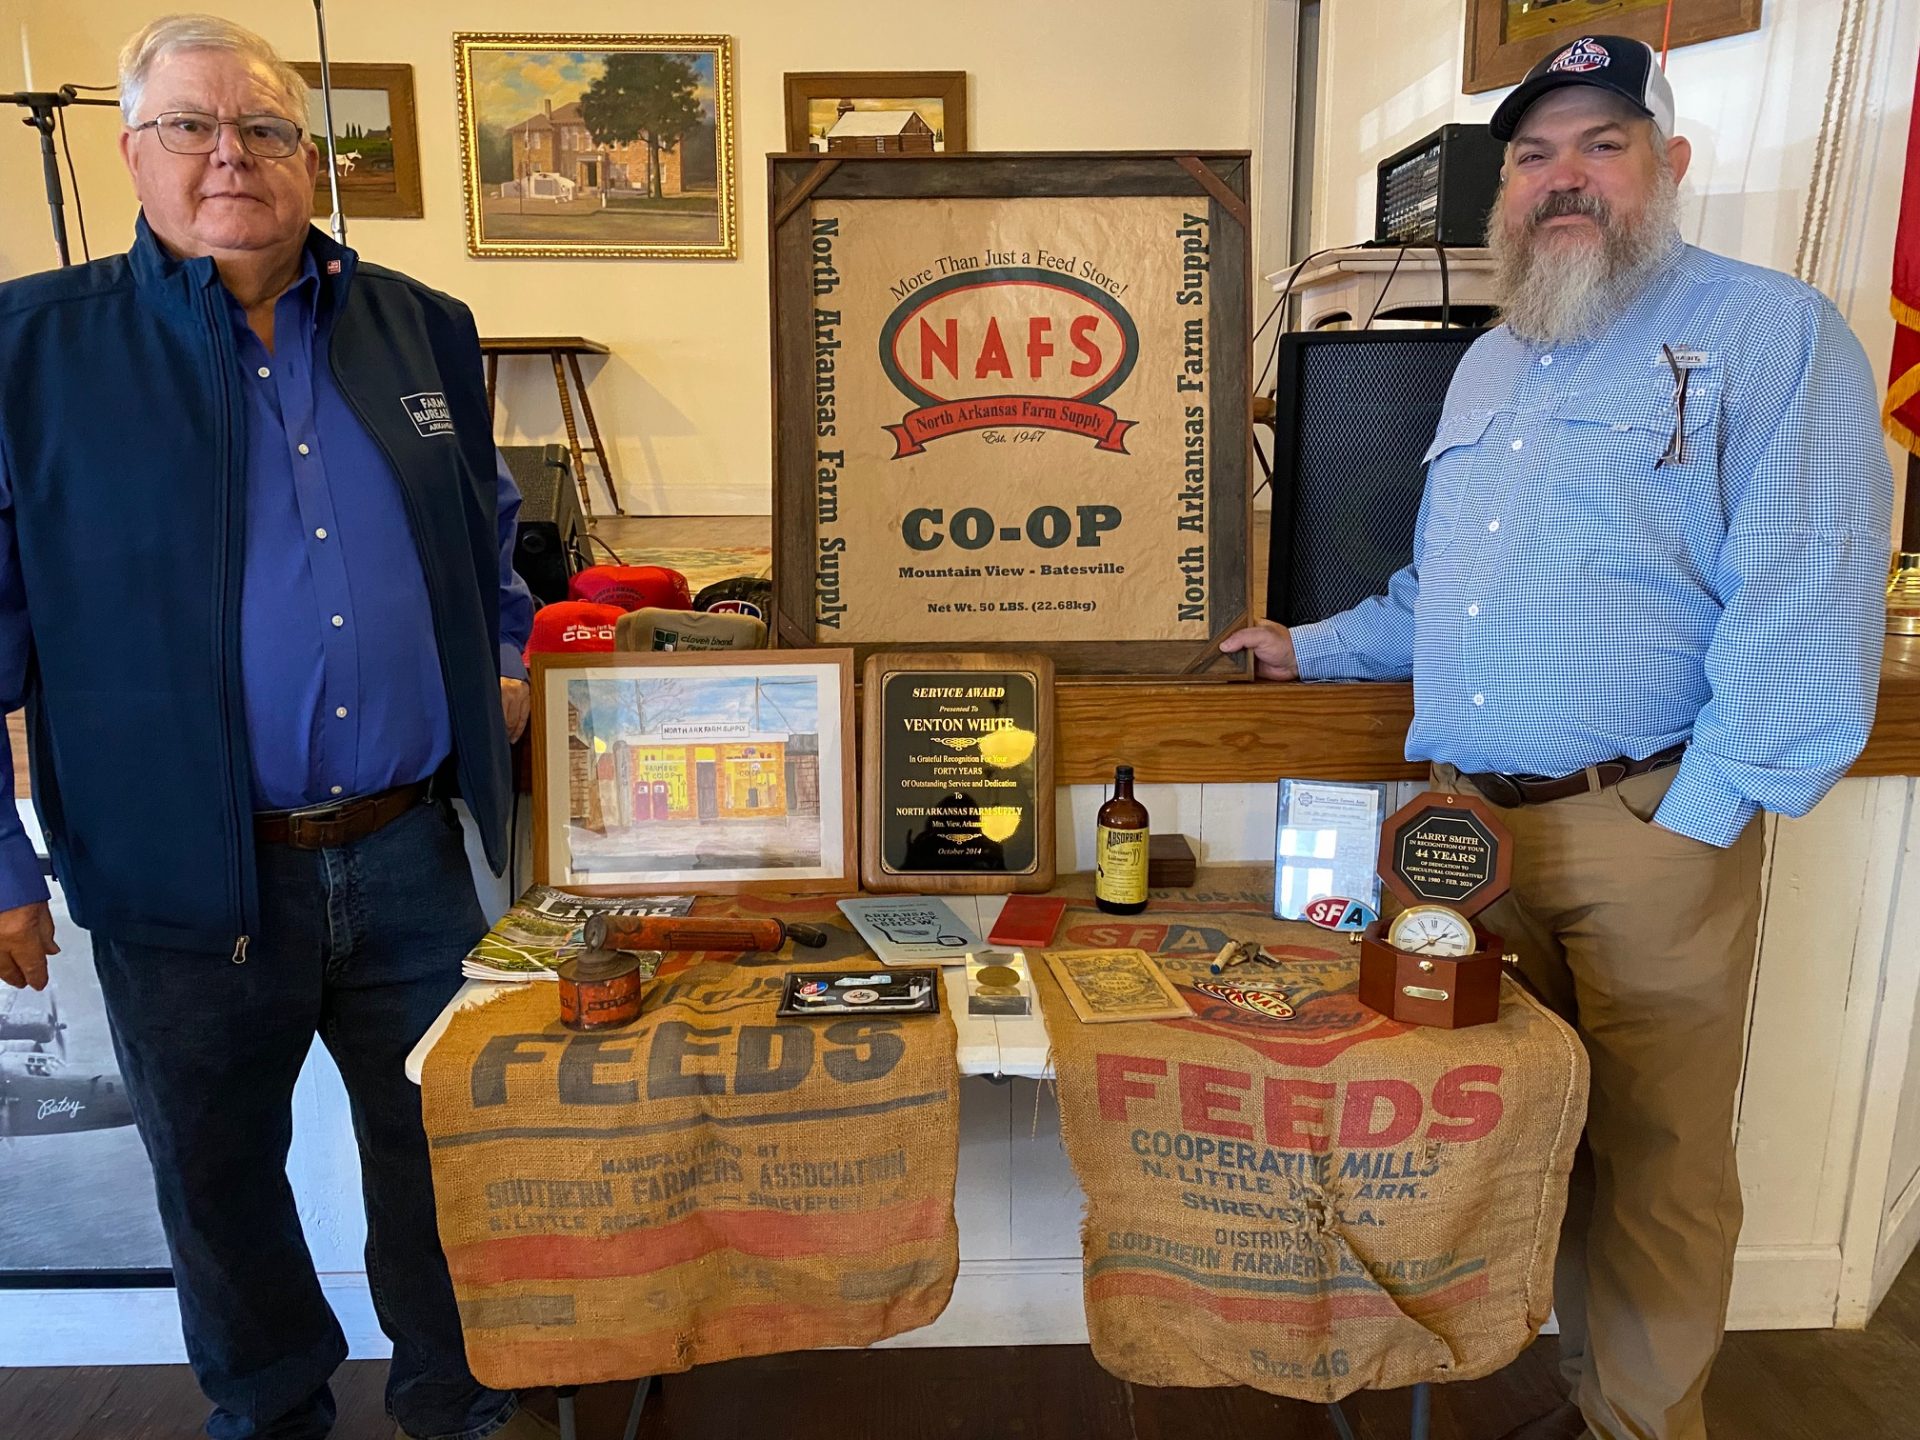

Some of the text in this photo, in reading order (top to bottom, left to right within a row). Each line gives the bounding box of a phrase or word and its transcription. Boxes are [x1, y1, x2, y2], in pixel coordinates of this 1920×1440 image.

[889, 249, 1129, 302] More Than Just a Feed Store!
[919, 314, 1103, 381] NAFS
[420, 397, 446, 409] FARM
[413, 408, 450, 422] BUREAU
[916, 402, 1104, 433] North Arkansas Farm Supply
[1176, 213, 1209, 621] North Arkansas Farm Supply
[812, 218, 847, 629] North Arkansas Farm Supply
[982, 431, 1046, 444] Est. 1947
[902, 505, 1122, 551] CO-OP
[899, 566, 982, 578] Mountain
[984, 565, 1025, 577] View
[1040, 563, 1125, 576] Batesville
[927, 600, 1097, 613] Net Wt. 50 LBS. (22.68kg)
[562, 630, 616, 642] CO-O
[912, 687, 1005, 698] SERVICE AWARD
[939, 705, 979, 713] Presented To
[903, 717, 1014, 732] VENTON WHITE
[909, 755, 916, 763] In
[917, 754, 942, 764] Grateful
[943, 755, 980, 765] Recognition
[933, 767, 983, 775] FORTY YEARS
[901, 779, 1017, 789] Of Outstanding Service and Dedication
[954, 792, 963, 800] To
[896, 807, 924, 816] NORTH
[925, 807, 968, 816] ARKANSAS
[968, 807, 993, 816] FARM
[1107, 831, 1143, 849] ABSORBINE
[1417, 832, 1479, 846] LARRY SMITH
[1417, 841, 1457, 850] RECOGNITION
[1415, 849, 1477, 863] 44 YEARS
[1405, 866, 1444, 875] AGRICULTURAL
[1428, 862, 1461, 870] DEDICATION
[533, 896, 677, 918] Living
[864, 911, 935, 919] ARKANSAS
[1312, 905, 1364, 928] SFA
[879, 919, 932, 927] SHOW
[1087, 928, 1209, 951] SFA
[1248, 992, 1291, 1015] NAFS
[471, 1020, 907, 1108] FEEDS
[37, 1096, 86, 1120] Betsy
[1097, 1053, 1504, 1150] FEEDS
[1131, 1129, 1440, 1185] COOPERATIVE MILLS
[485, 1178, 614, 1209] SOUTHERN
[632, 1158, 743, 1205] FARMERS
[1177, 1164, 1274, 1195] LITTLE
[1355, 1182, 1428, 1201] ARK.
[1107, 1231, 1220, 1268] SOUTHERN
[1311, 1349, 1350, 1377] 46
